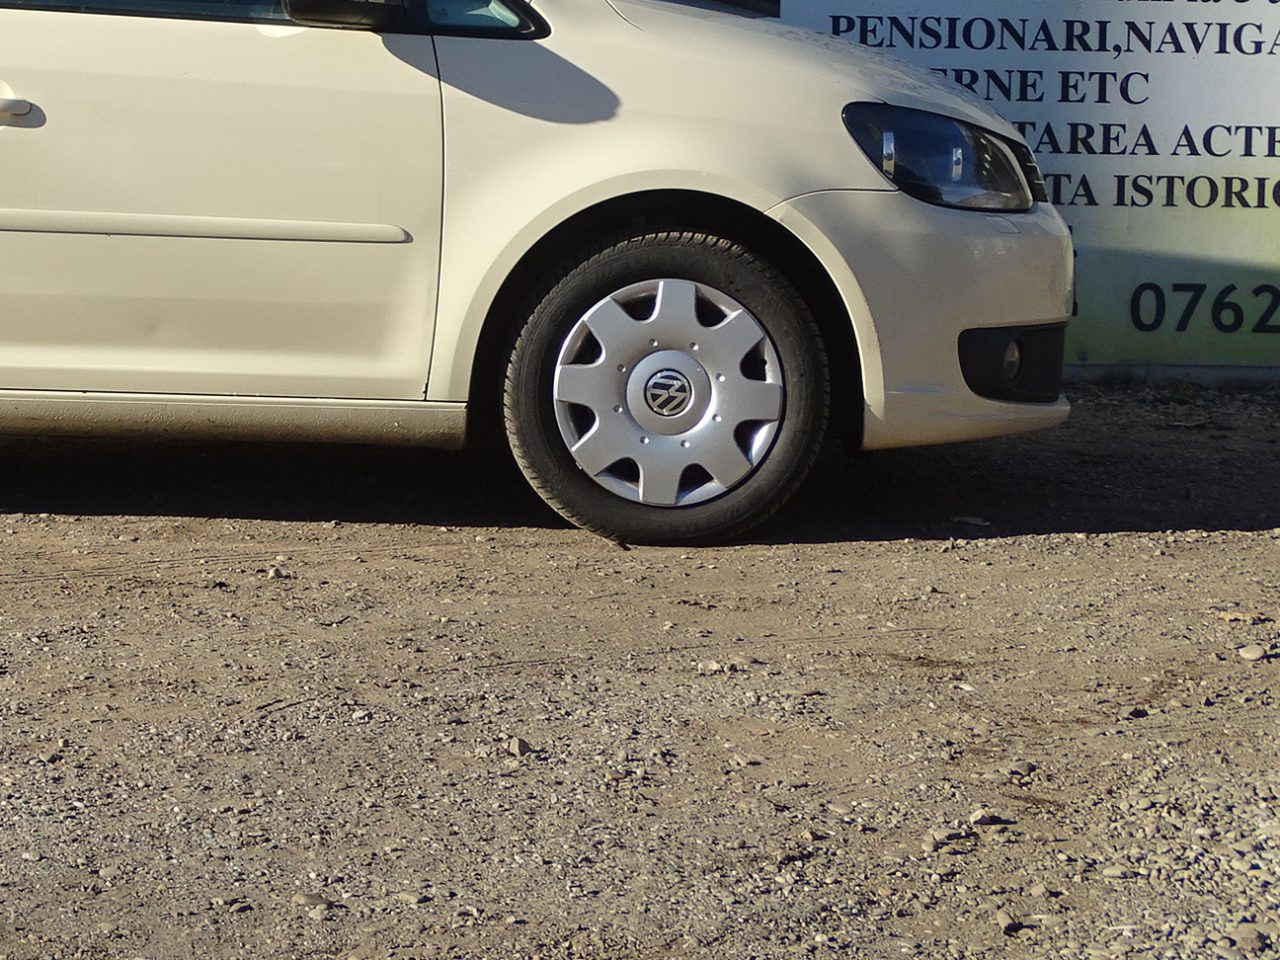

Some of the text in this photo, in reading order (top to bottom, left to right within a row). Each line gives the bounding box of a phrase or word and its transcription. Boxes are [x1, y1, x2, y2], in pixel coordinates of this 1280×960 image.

[1057, 71, 1150, 105] ETC
[1113, 174, 1280, 209] ISTORI
[1129, 281, 1280, 334] 0762
